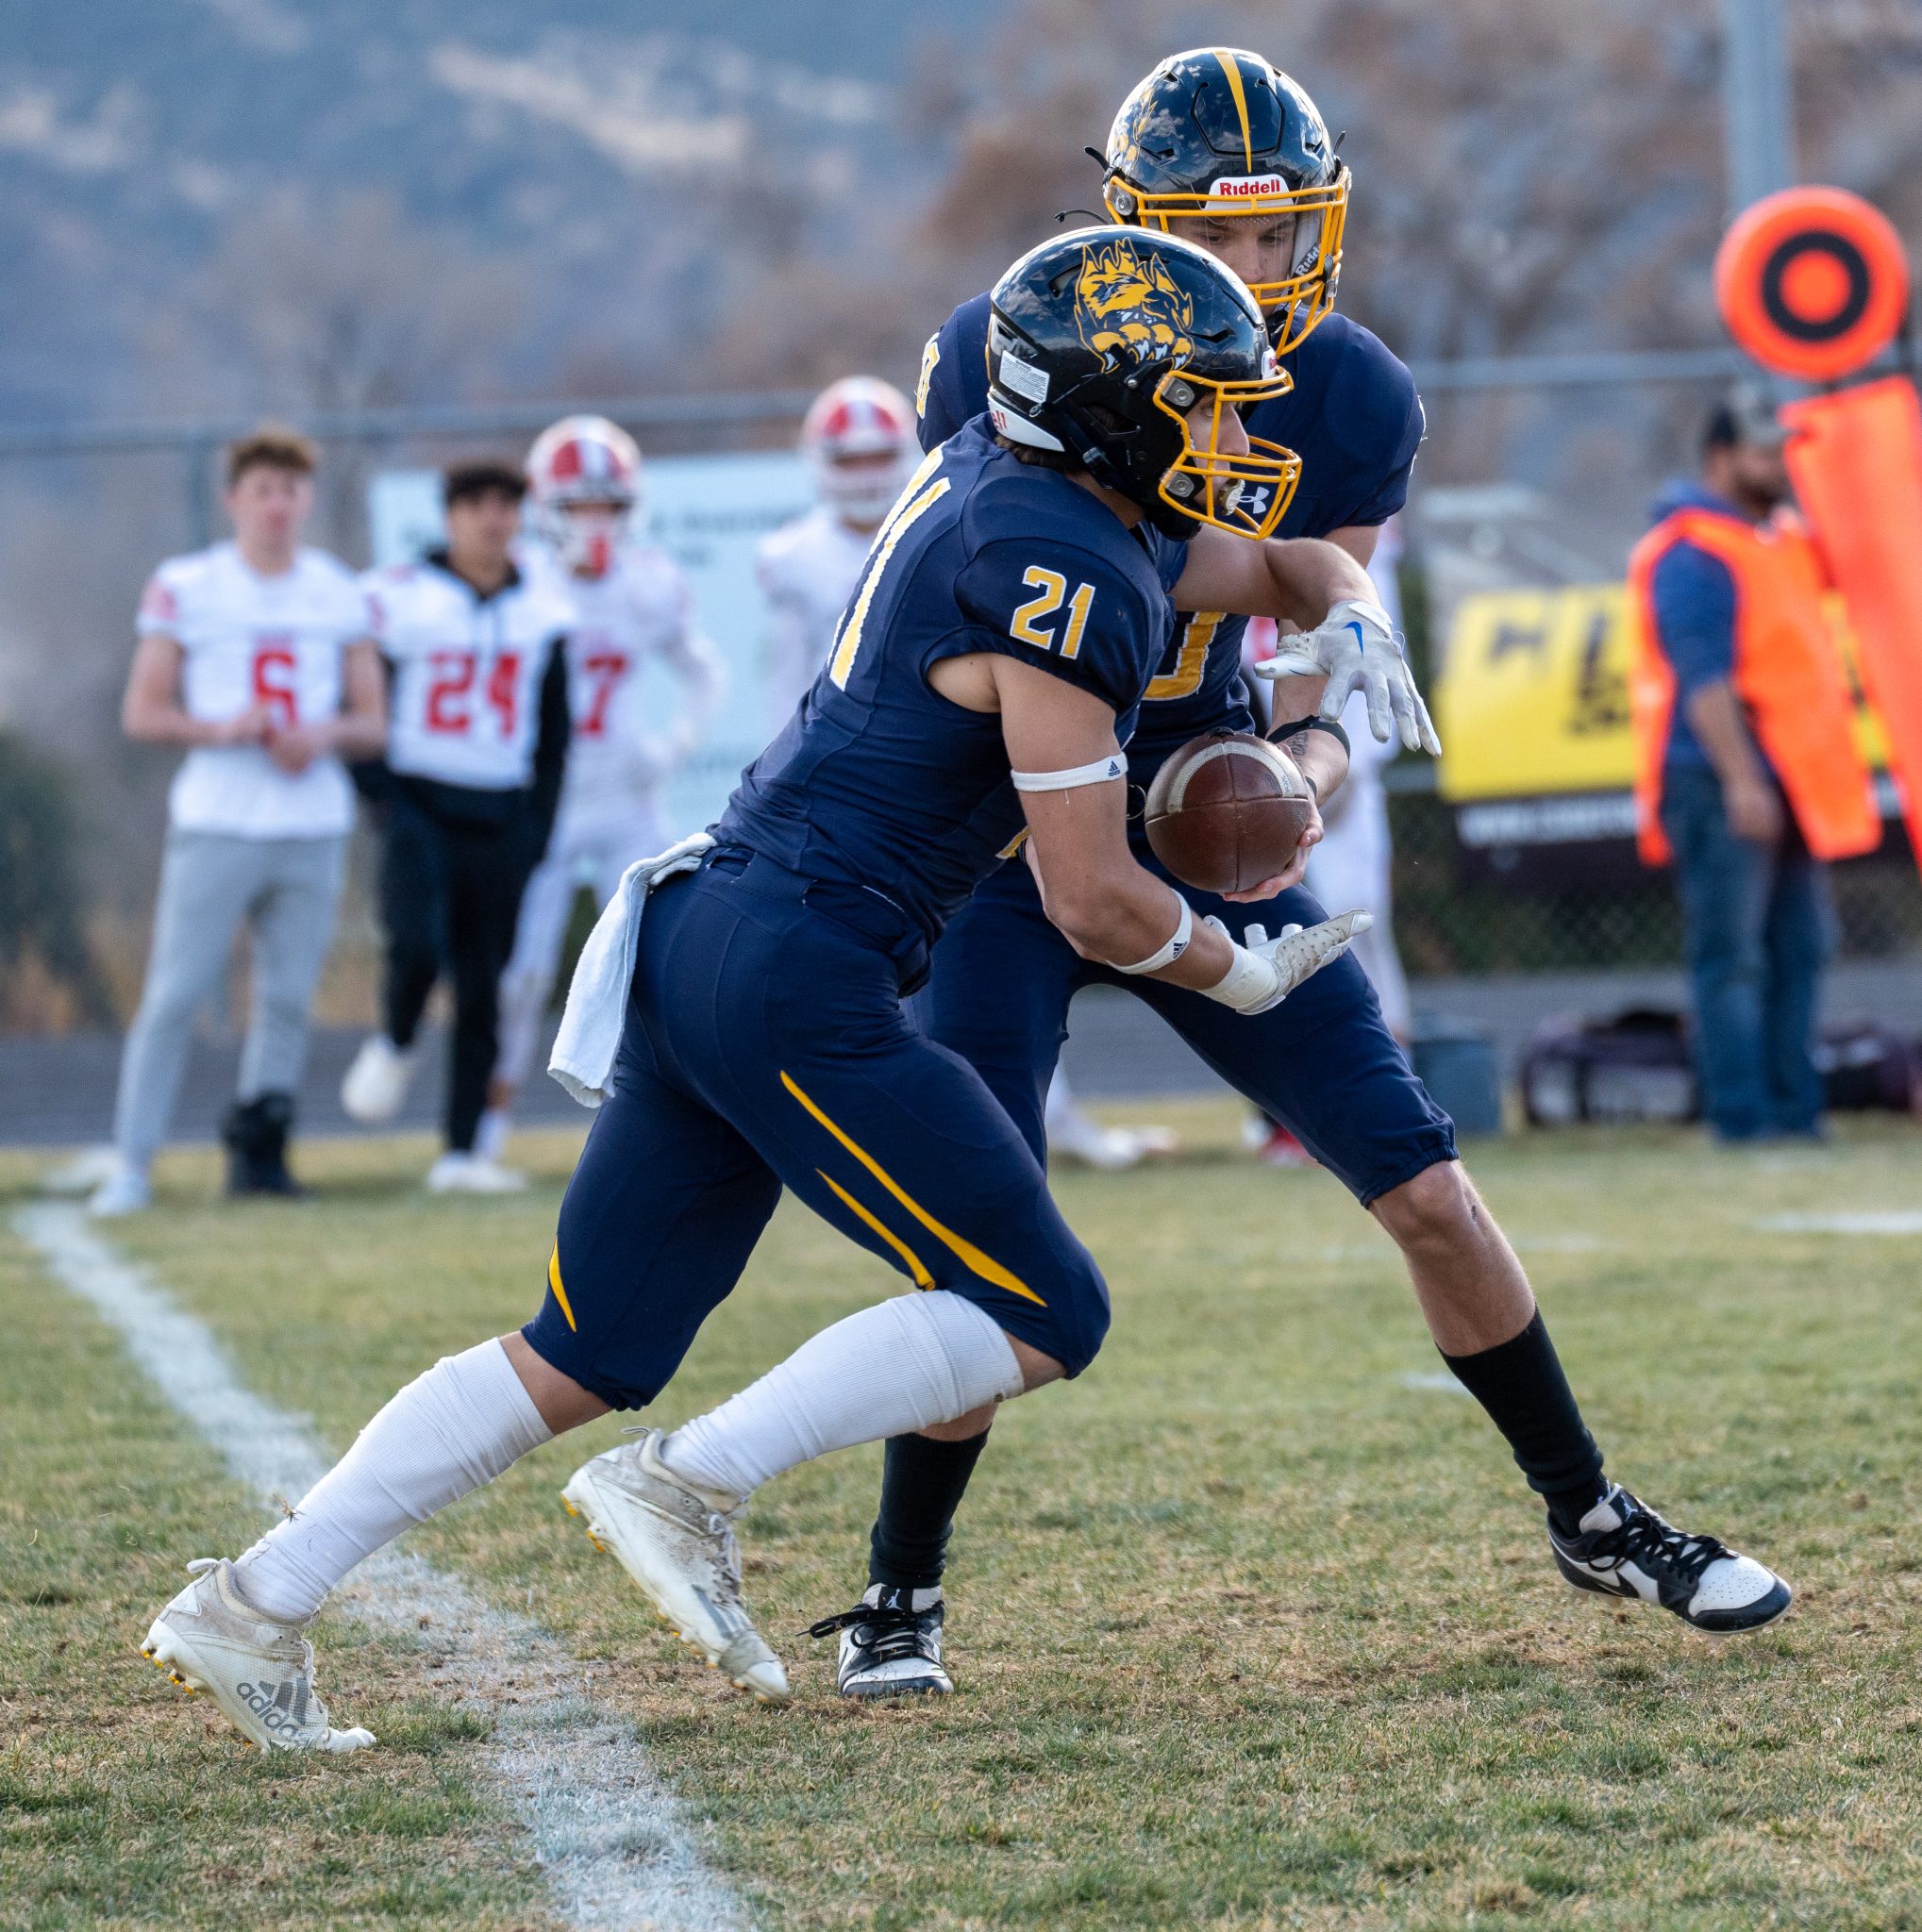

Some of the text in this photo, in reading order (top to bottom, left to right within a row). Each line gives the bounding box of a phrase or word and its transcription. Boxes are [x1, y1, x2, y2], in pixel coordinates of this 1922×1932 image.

[1219, 178, 1280, 196] Riddell
[1295, 245, 1320, 276] Ridd
[1010, 565, 1095, 660] 21
[426, 653, 521, 739] 24
